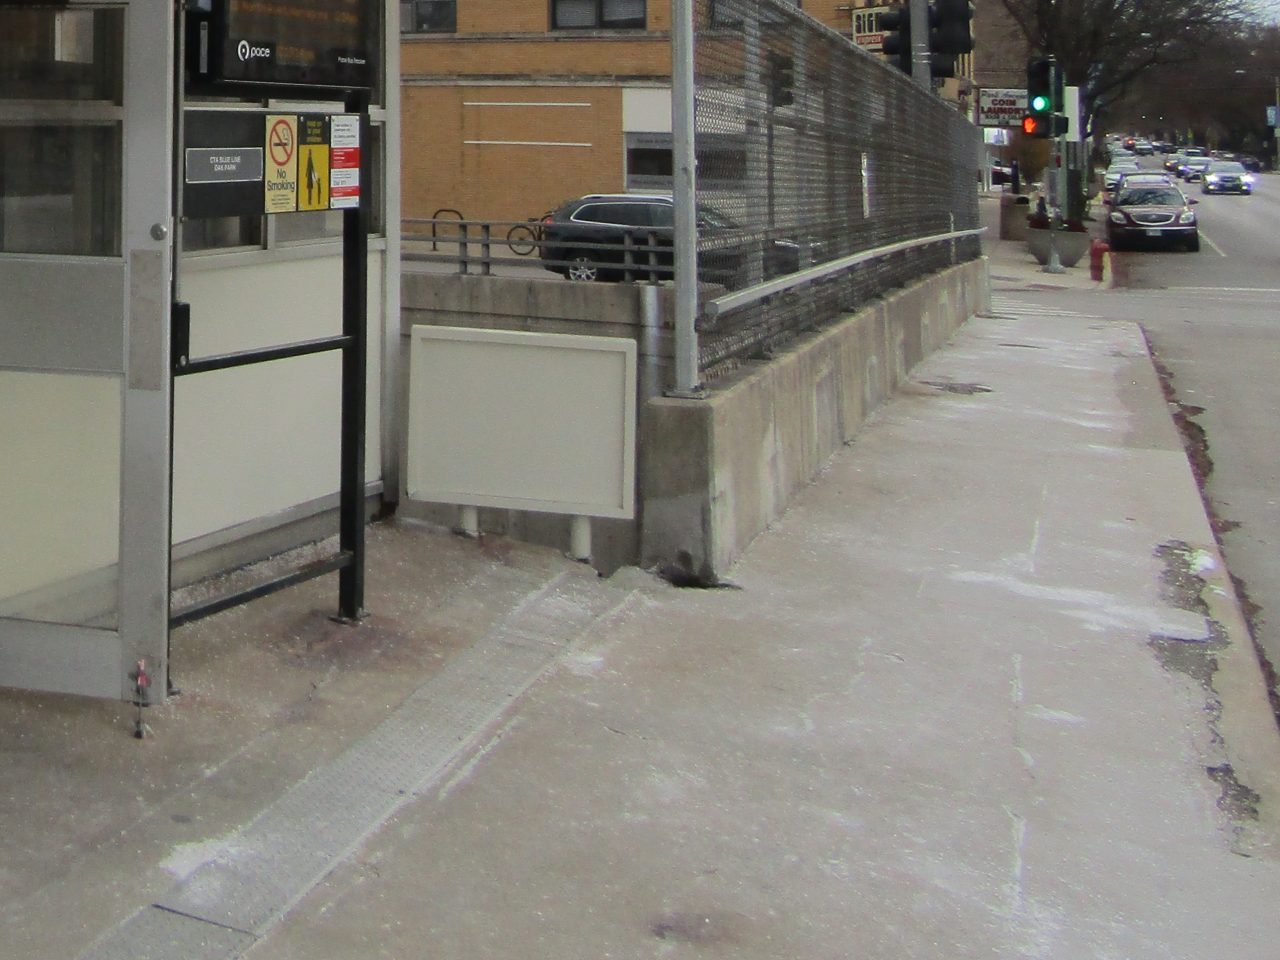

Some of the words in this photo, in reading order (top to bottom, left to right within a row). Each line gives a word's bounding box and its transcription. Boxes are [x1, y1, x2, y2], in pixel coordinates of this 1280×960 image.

[250, 47, 270, 58] pace
[209, 156, 218, 164] CTA
[277, 168, 287, 179] No
[267, 180, 295, 192] Smoking
